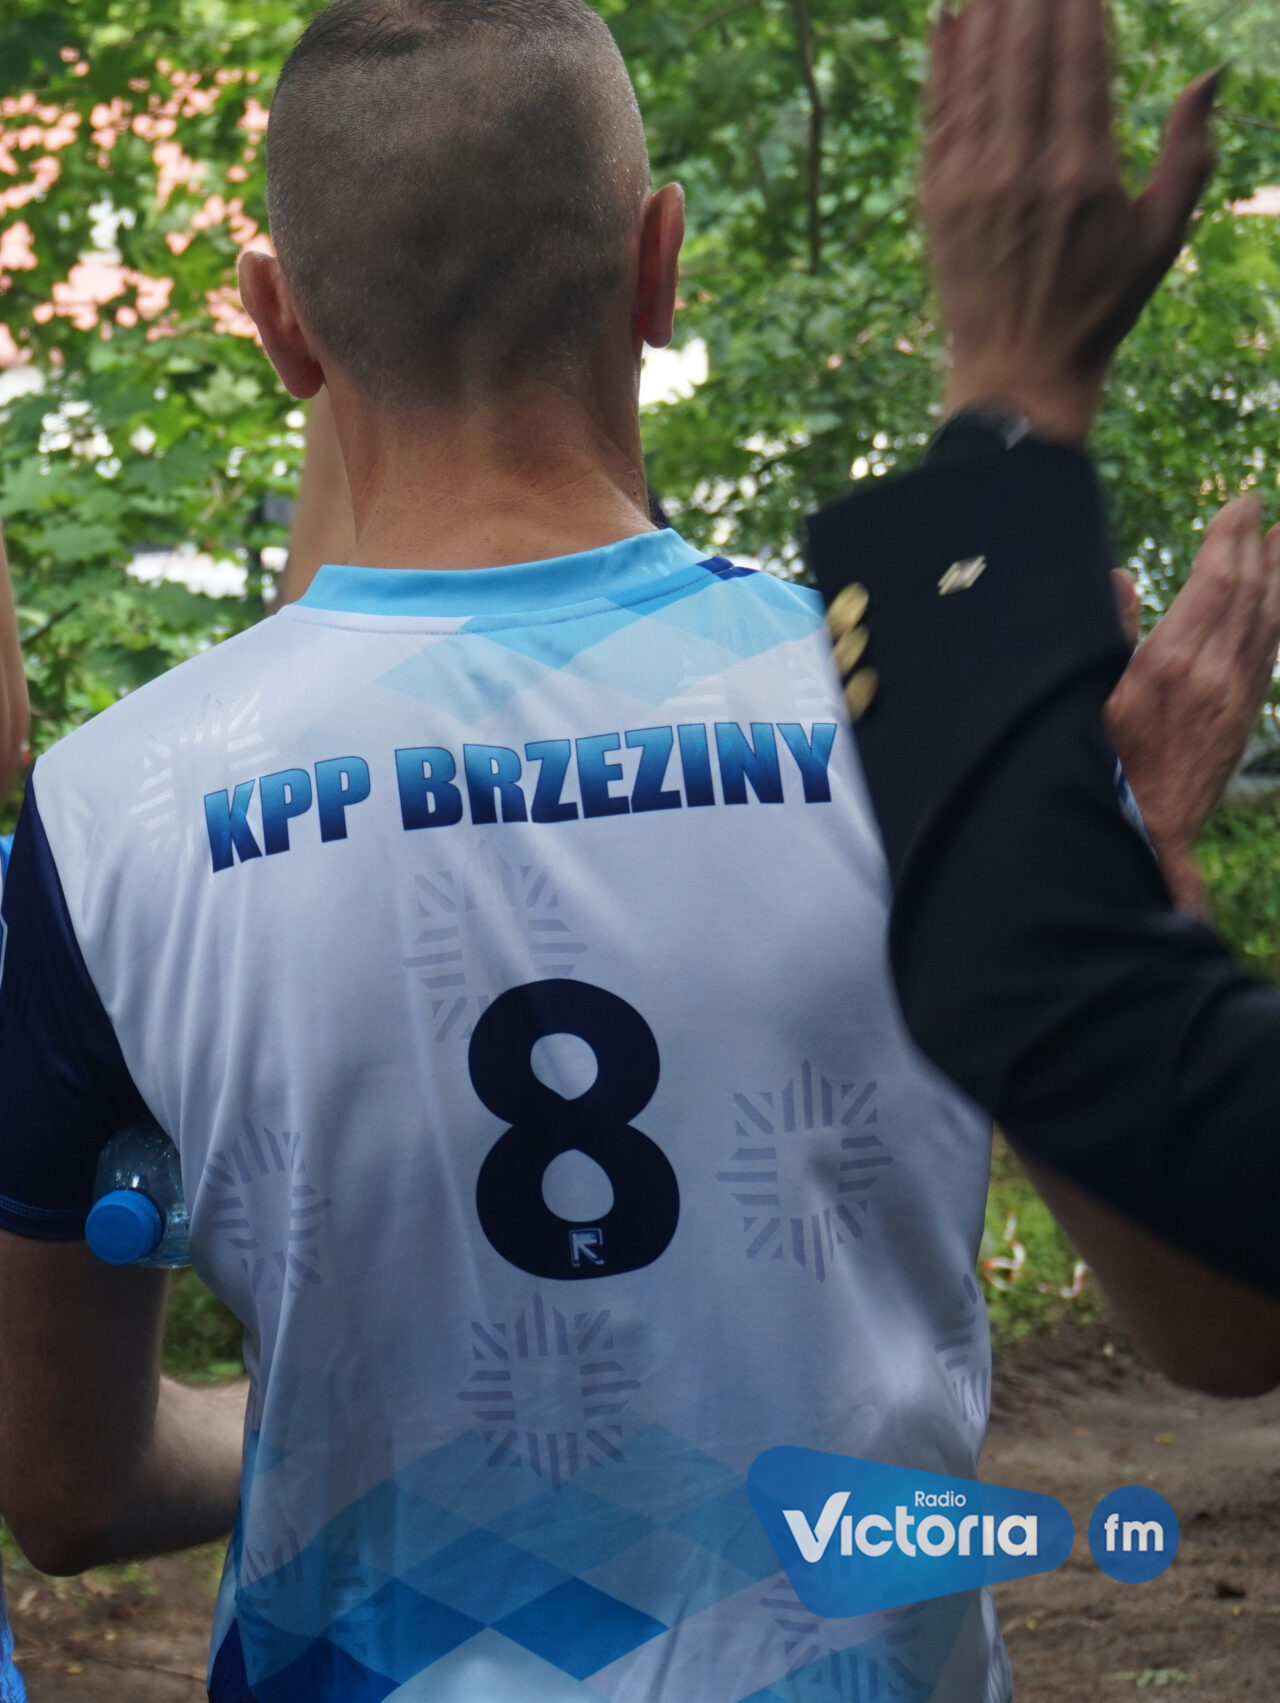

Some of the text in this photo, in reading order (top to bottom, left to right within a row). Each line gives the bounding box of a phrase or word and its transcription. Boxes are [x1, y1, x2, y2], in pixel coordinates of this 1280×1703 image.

[203, 722, 837, 873] KPP BRZEZINY
[468, 979, 680, 1280] 8
